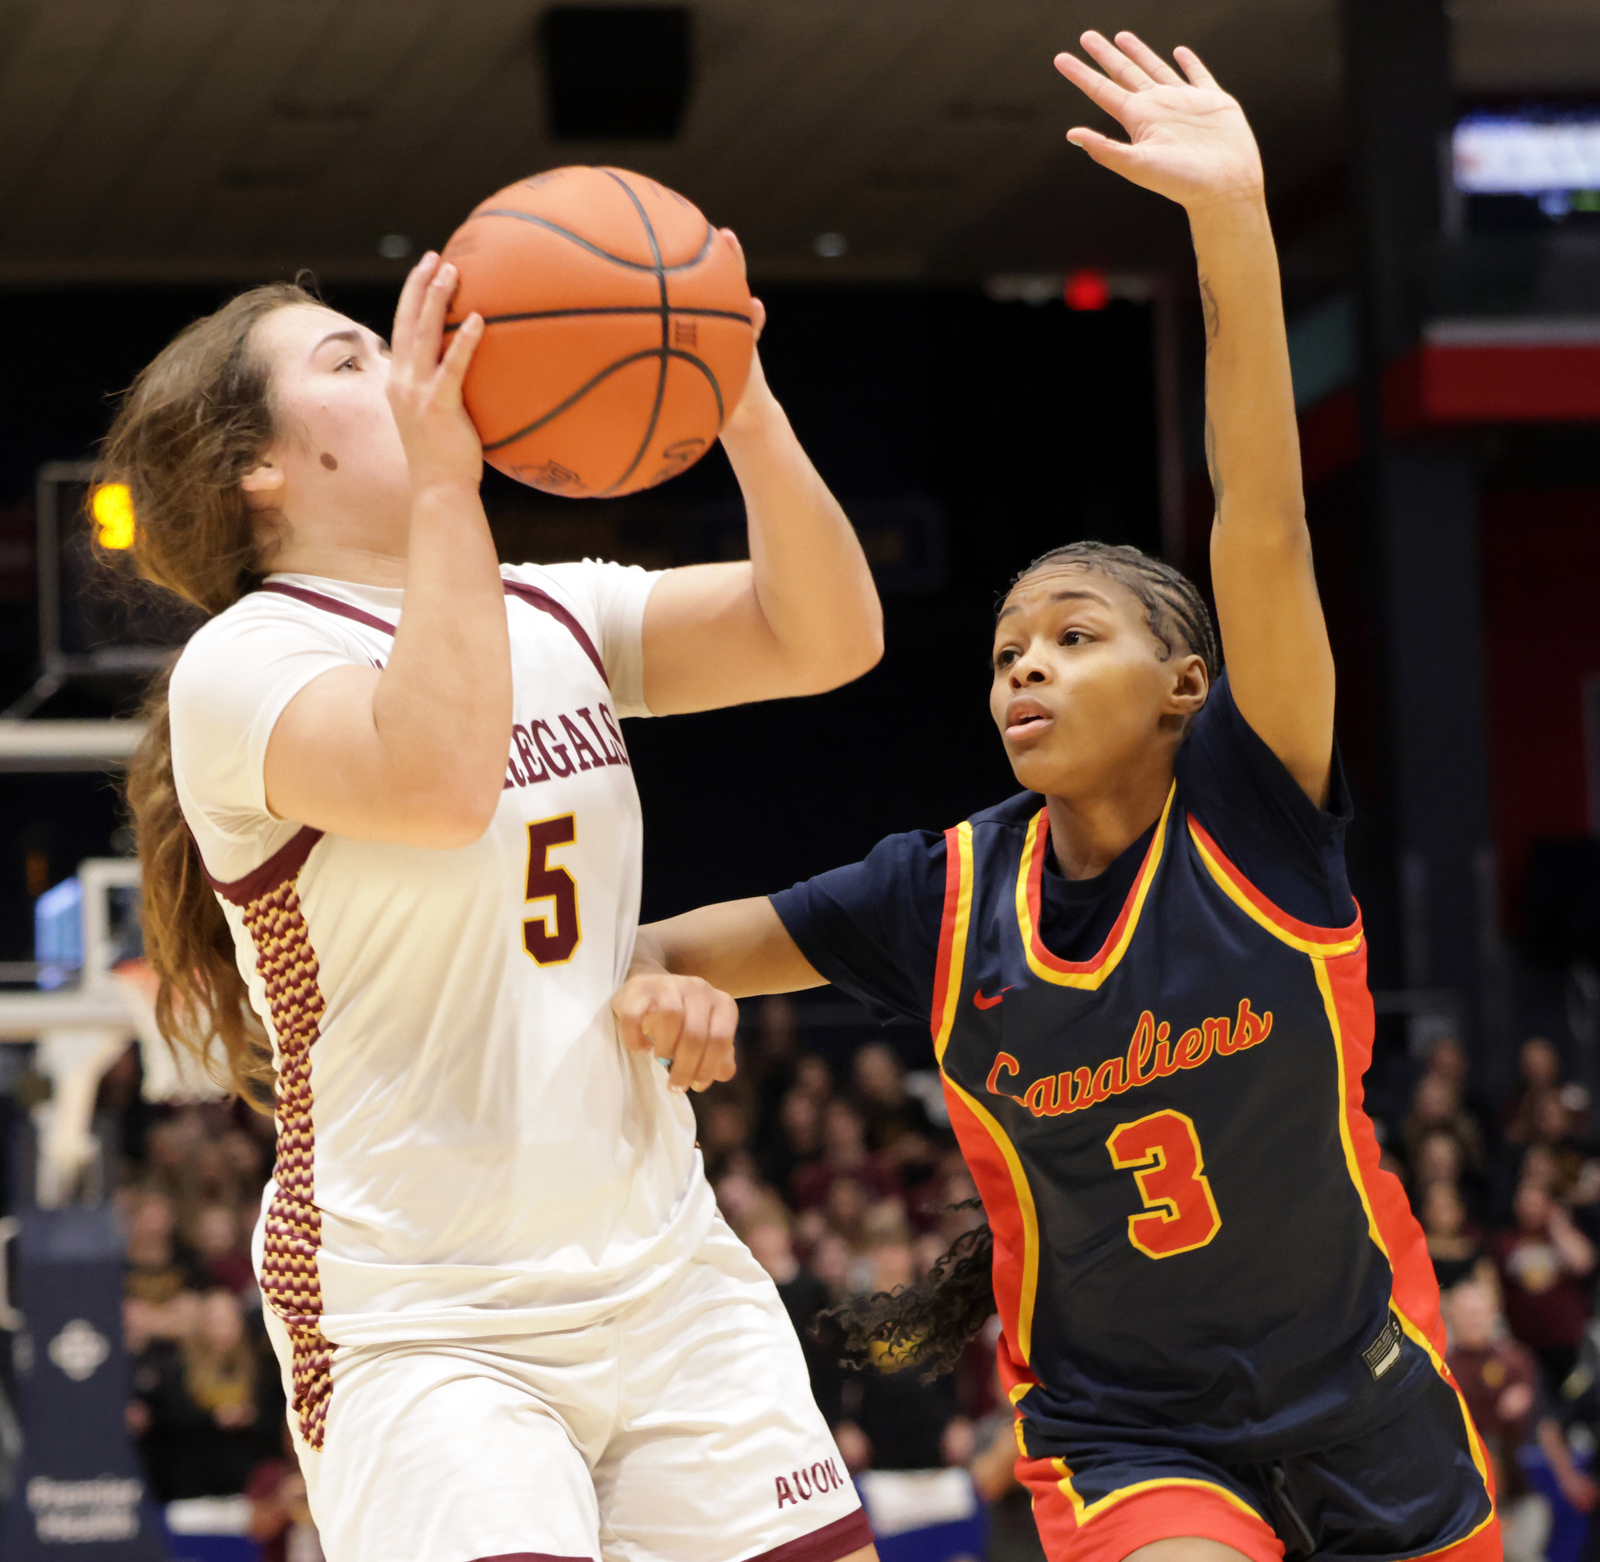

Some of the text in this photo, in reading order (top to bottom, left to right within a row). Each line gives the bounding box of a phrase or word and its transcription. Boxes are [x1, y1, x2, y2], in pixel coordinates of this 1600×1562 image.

[521, 811, 582, 968] 5
[986, 998, 1273, 1117] Cavaliers
[1105, 1108, 1222, 1260] 3
